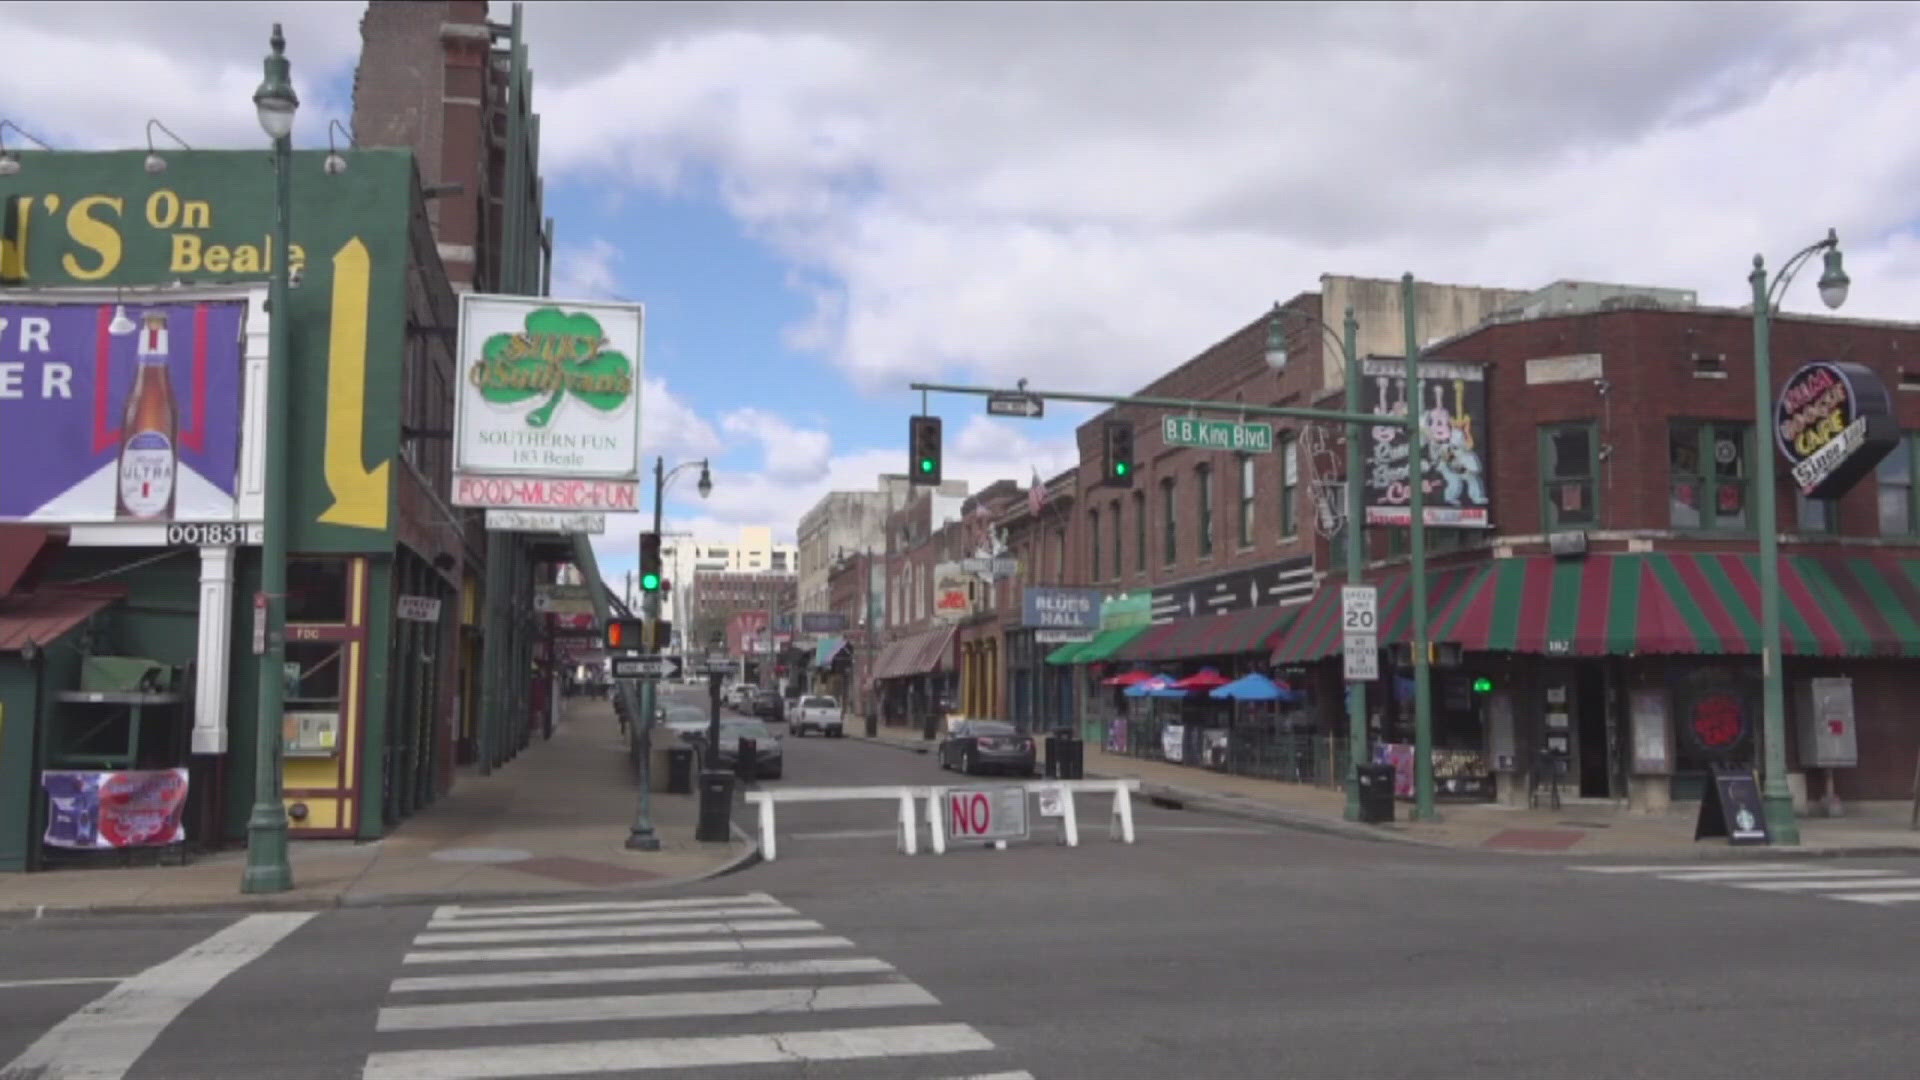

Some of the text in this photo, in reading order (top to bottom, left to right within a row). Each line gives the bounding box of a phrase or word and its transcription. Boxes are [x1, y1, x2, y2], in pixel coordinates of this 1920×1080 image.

[145, 189, 210, 229] On
[170, 233, 305, 274] Beale
[479, 431, 617, 449] SOUTHERN FUN
[1199, 422, 1228, 447] King
[1234, 425, 1268, 448] Blvd.
[513, 449, 538, 464] 183
[168, 524, 248, 544] 001831
[1040, 611, 1083, 625] HALL
[1345, 611, 1373, 627] 20
[951, 791, 991, 835] NO
